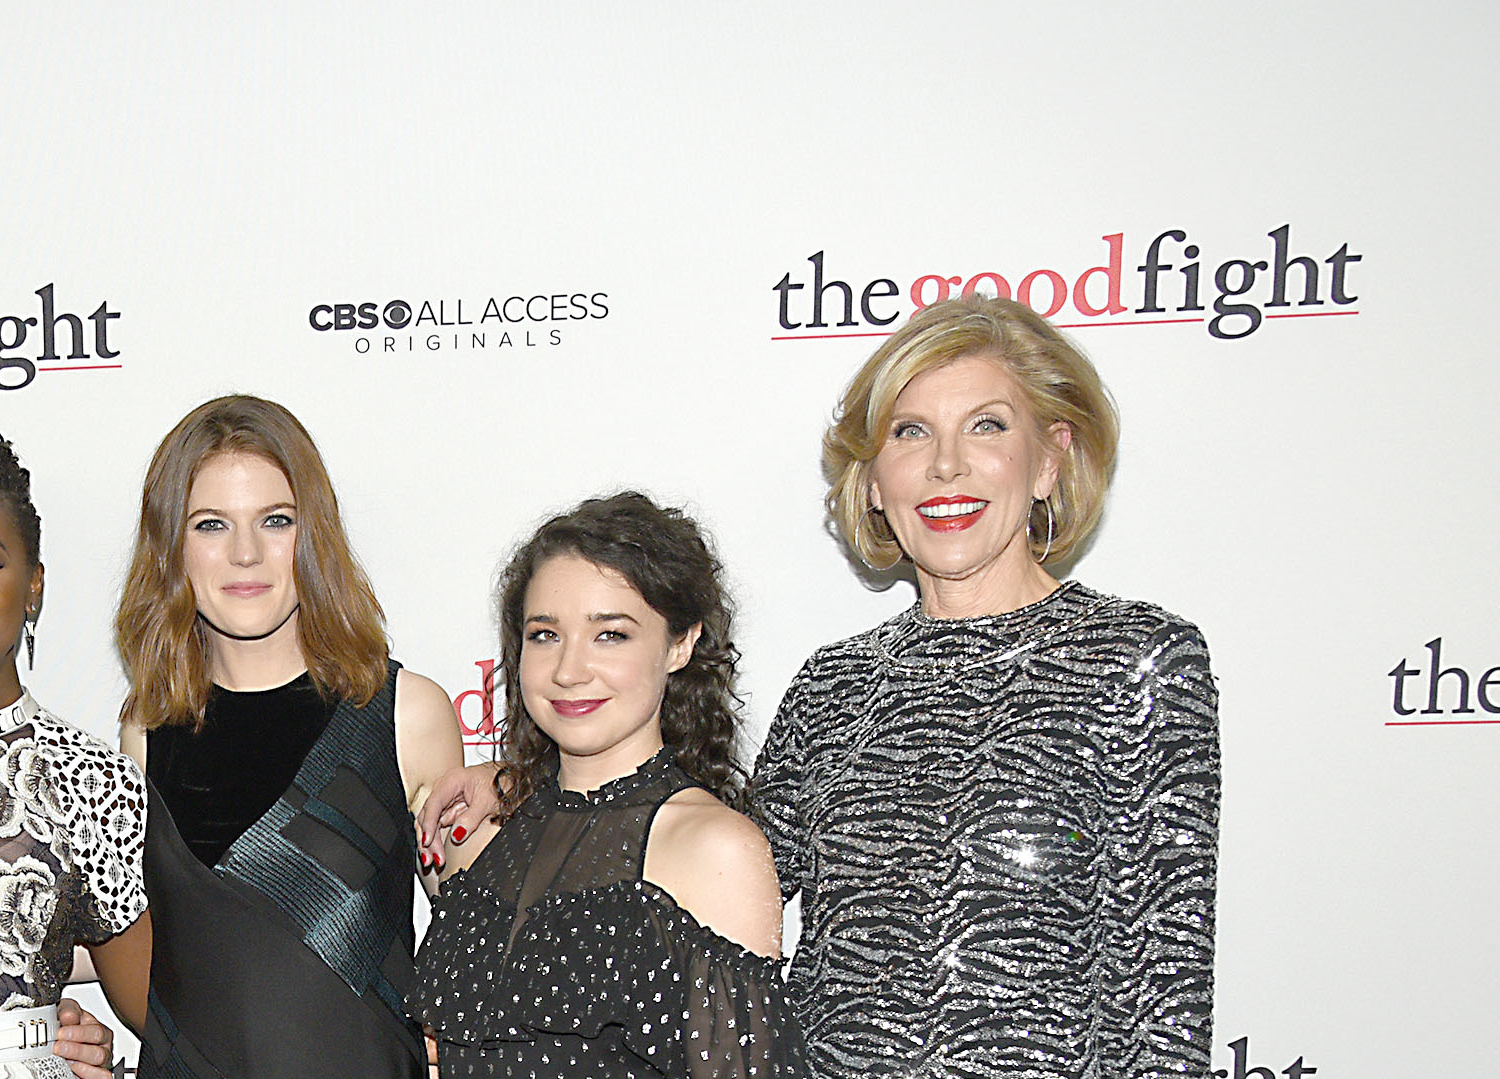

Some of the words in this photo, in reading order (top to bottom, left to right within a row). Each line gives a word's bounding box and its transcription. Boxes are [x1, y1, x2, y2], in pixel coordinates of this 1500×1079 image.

[415, 299, 473, 327] ALL
[480, 293, 608, 324] ACCESS
[355, 329, 561, 353] ORIGINALS
